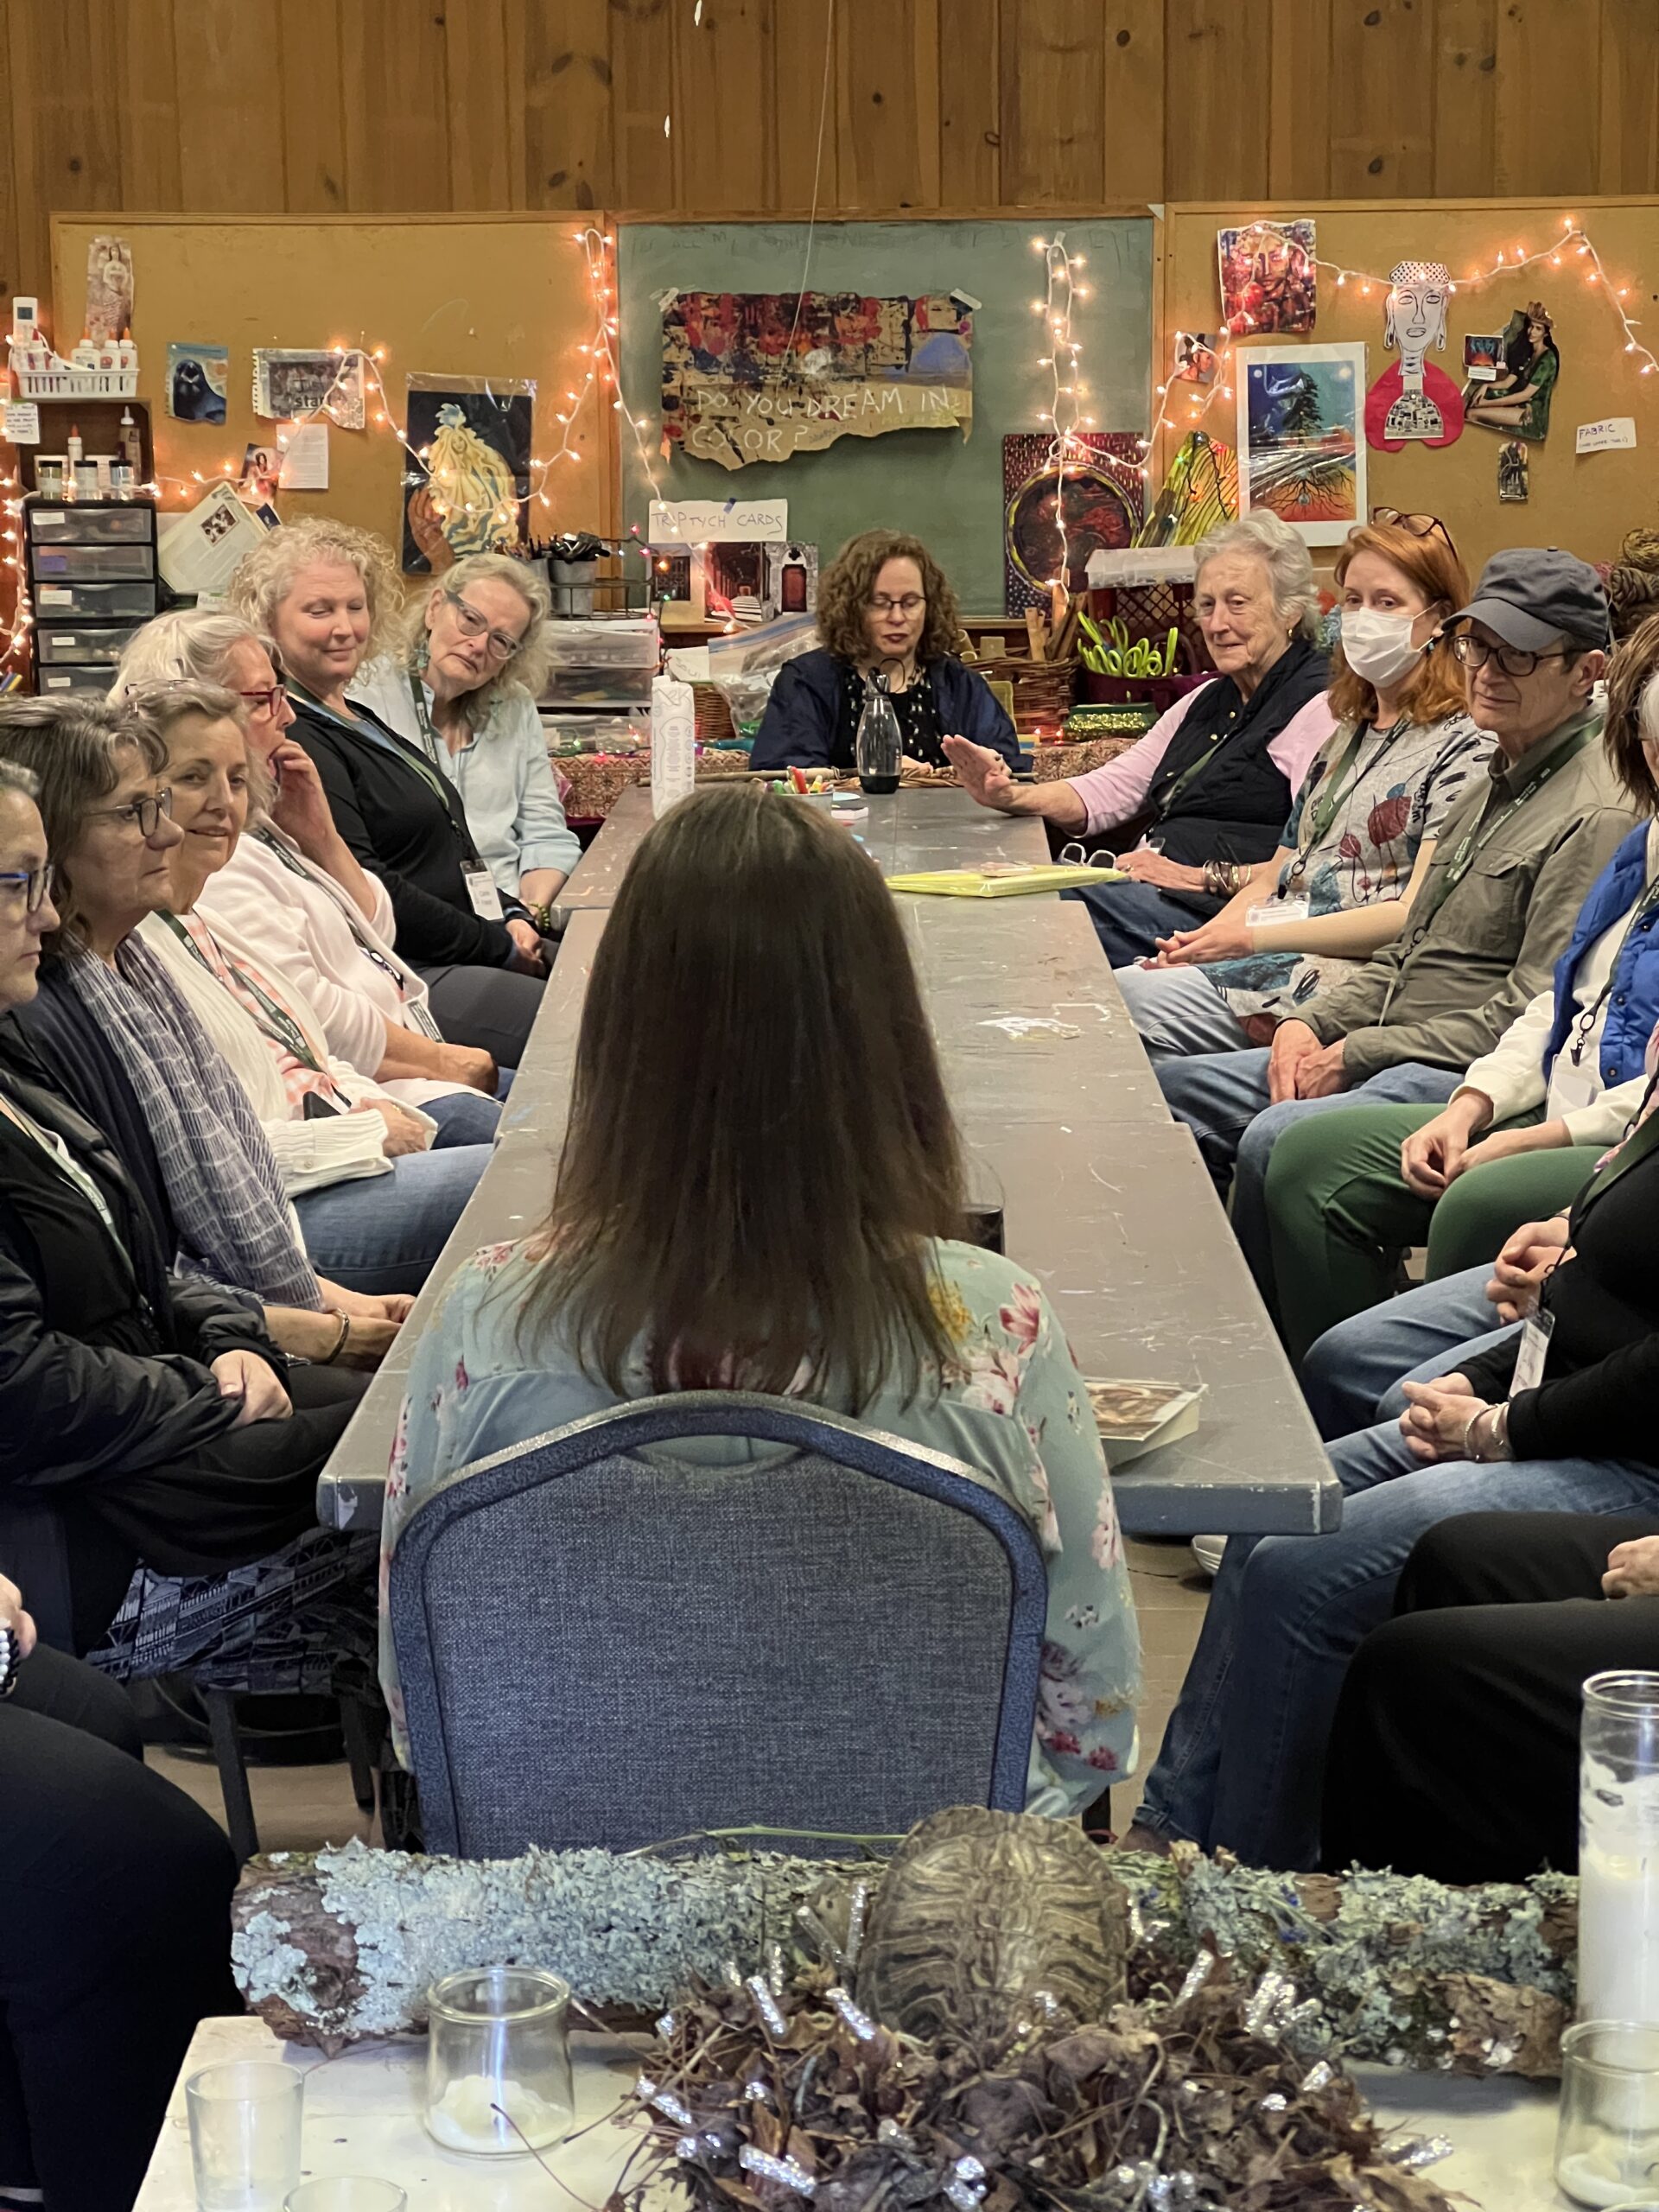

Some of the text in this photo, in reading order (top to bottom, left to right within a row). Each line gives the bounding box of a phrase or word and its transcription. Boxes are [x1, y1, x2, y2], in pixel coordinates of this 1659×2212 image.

[697, 390, 728, 411] DO
[744, 393, 792, 415] YOU
[806, 388, 904, 421] DREAM
[921, 384, 950, 412] IN
[1579, 423, 1616, 440] FABRIC
[652, 512, 783, 537] TRIPTYCH CARDS
